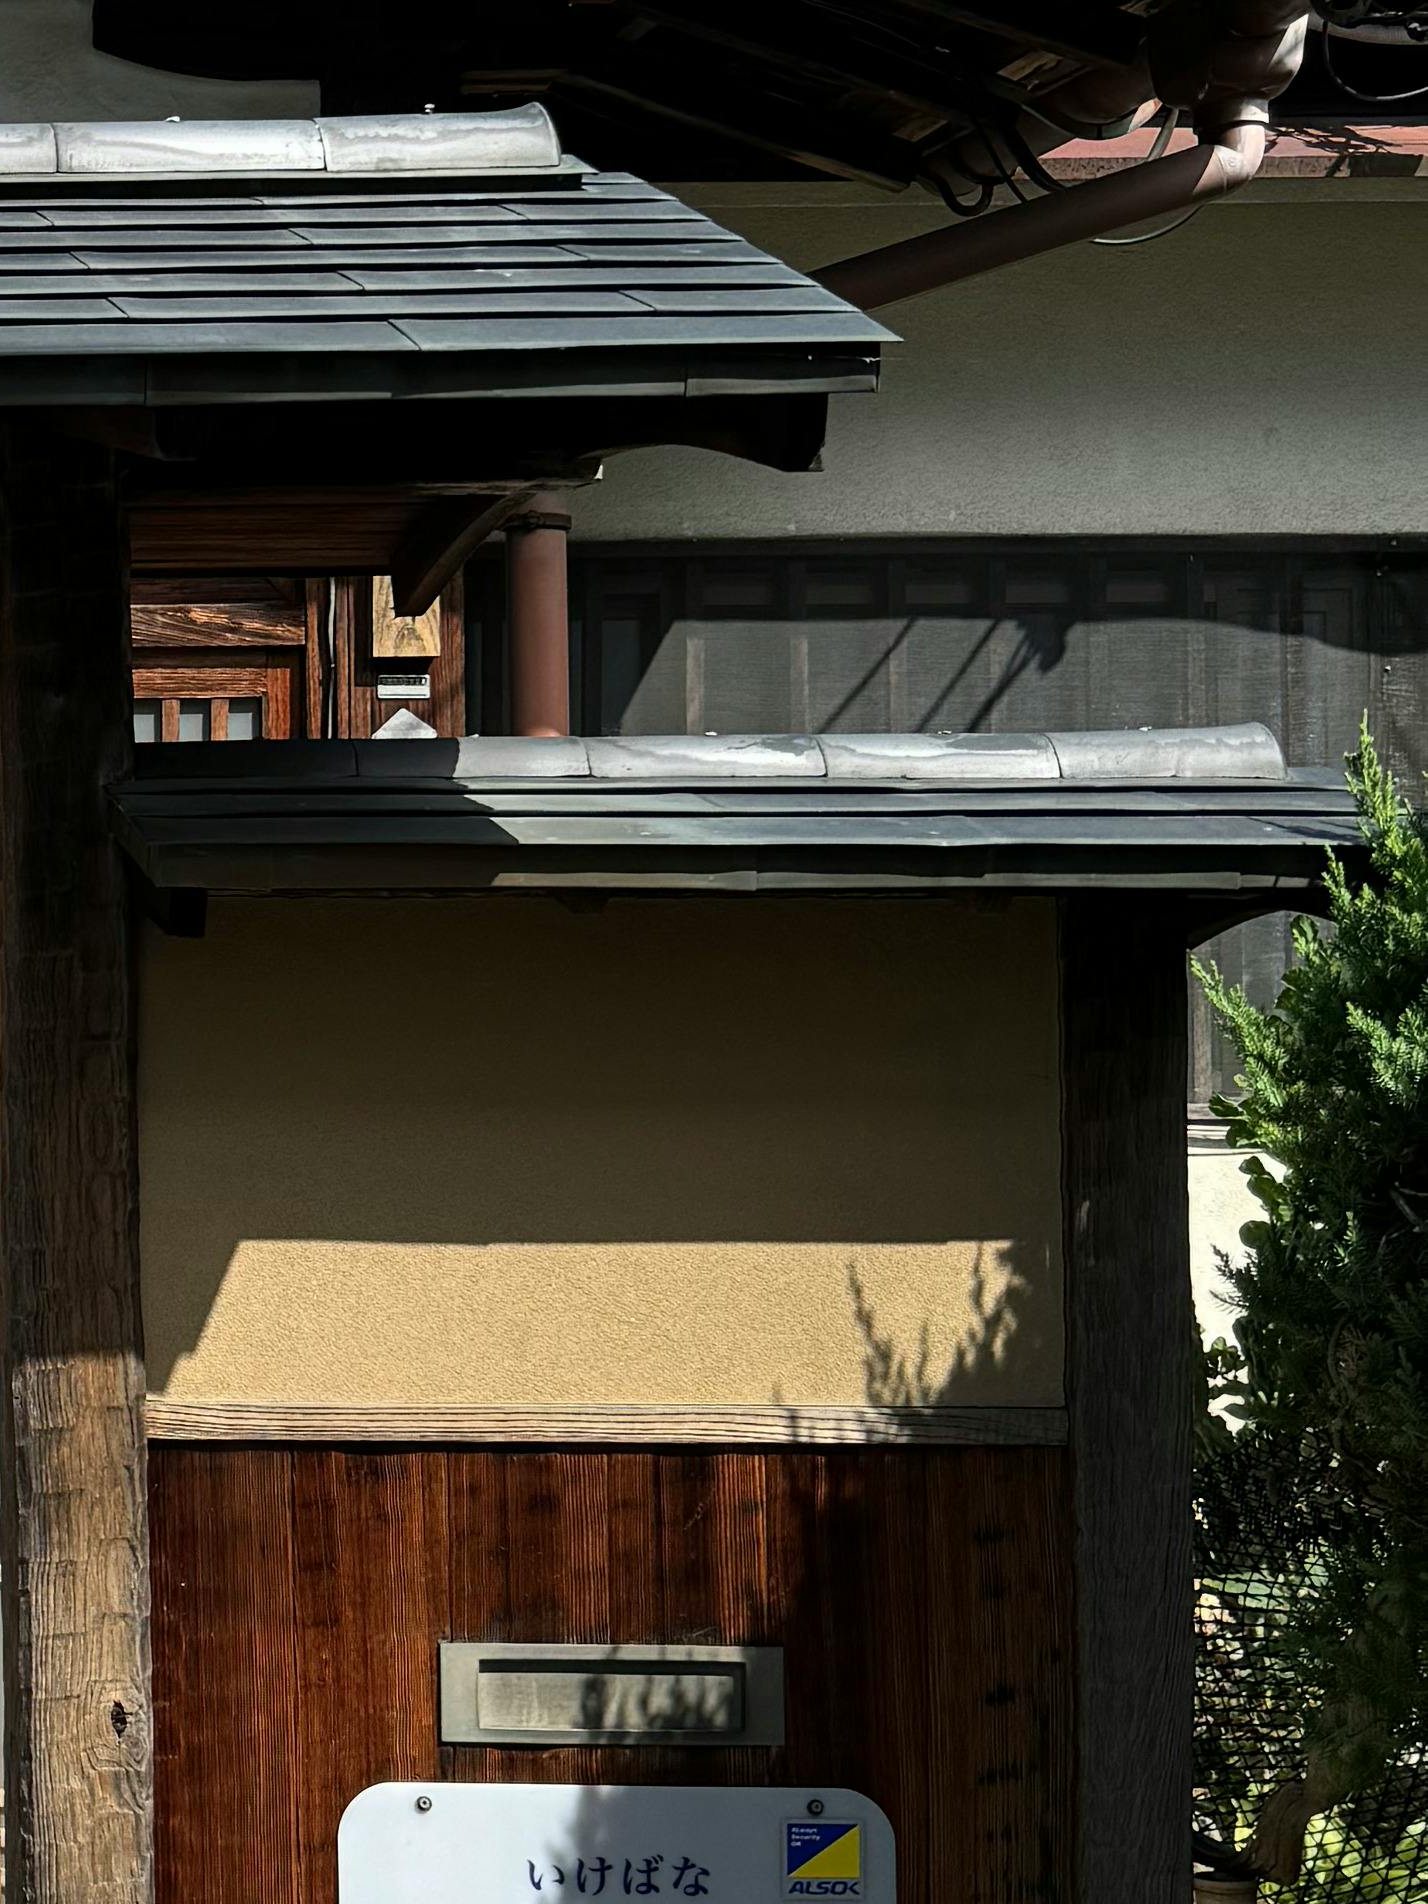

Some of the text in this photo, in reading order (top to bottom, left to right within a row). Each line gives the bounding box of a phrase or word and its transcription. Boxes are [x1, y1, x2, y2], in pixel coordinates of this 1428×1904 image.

[527, 1854, 710, 1896] いけばな
[788, 1881, 861, 1895] ALSOK
